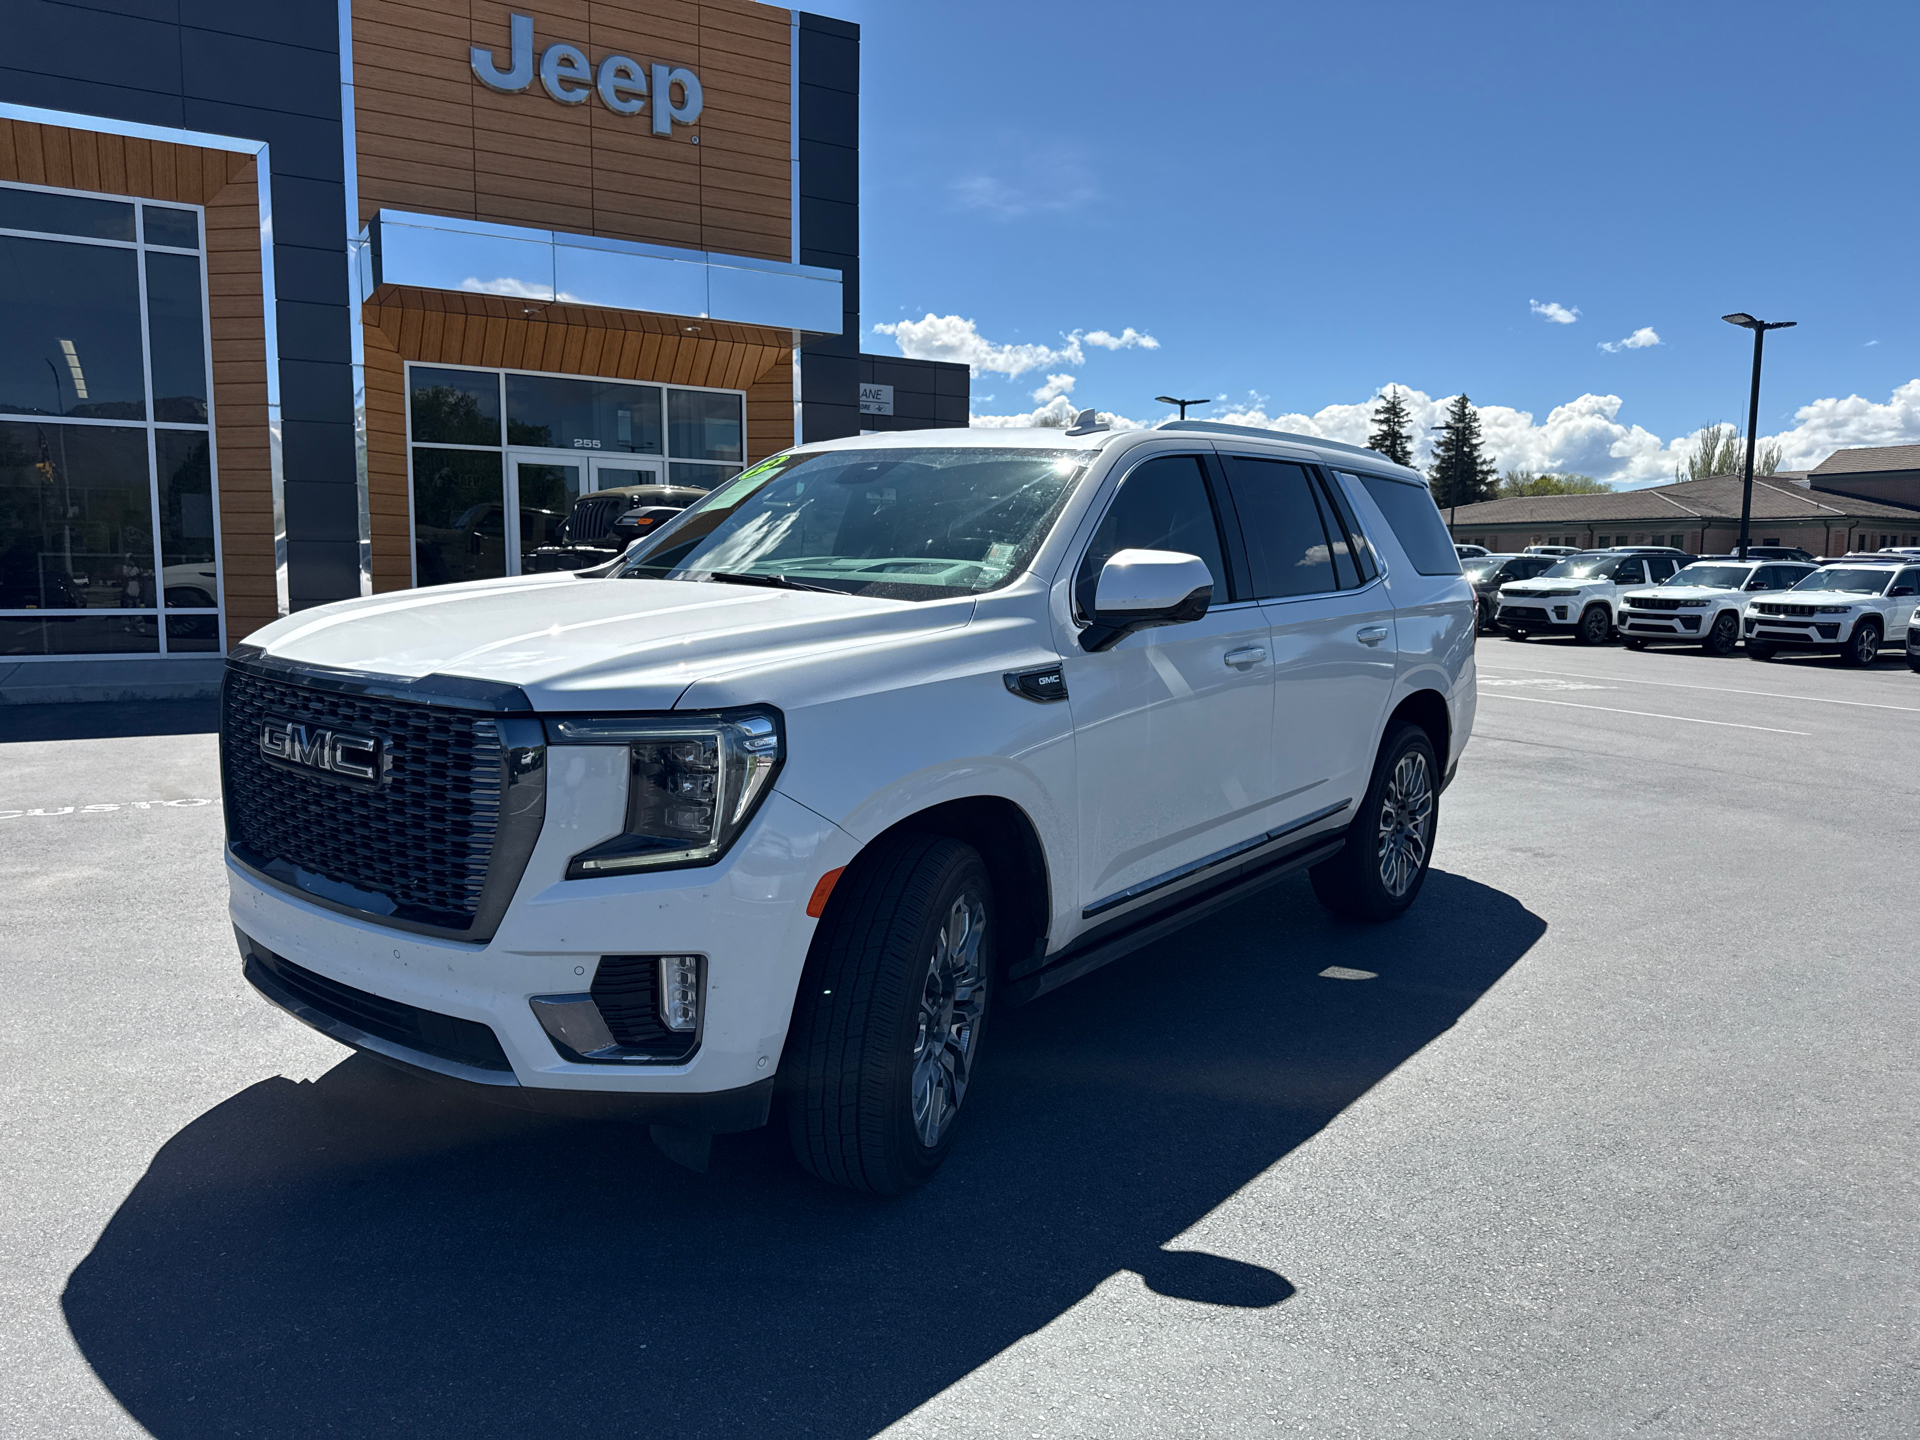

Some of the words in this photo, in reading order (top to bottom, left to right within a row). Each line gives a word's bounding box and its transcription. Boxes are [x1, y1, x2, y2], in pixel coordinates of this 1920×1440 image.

[470, 13, 703, 137] Jeep
[573, 438, 601, 449] 255
[1038, 675, 1060, 685] GMC
[261, 718, 375, 779] GMC
